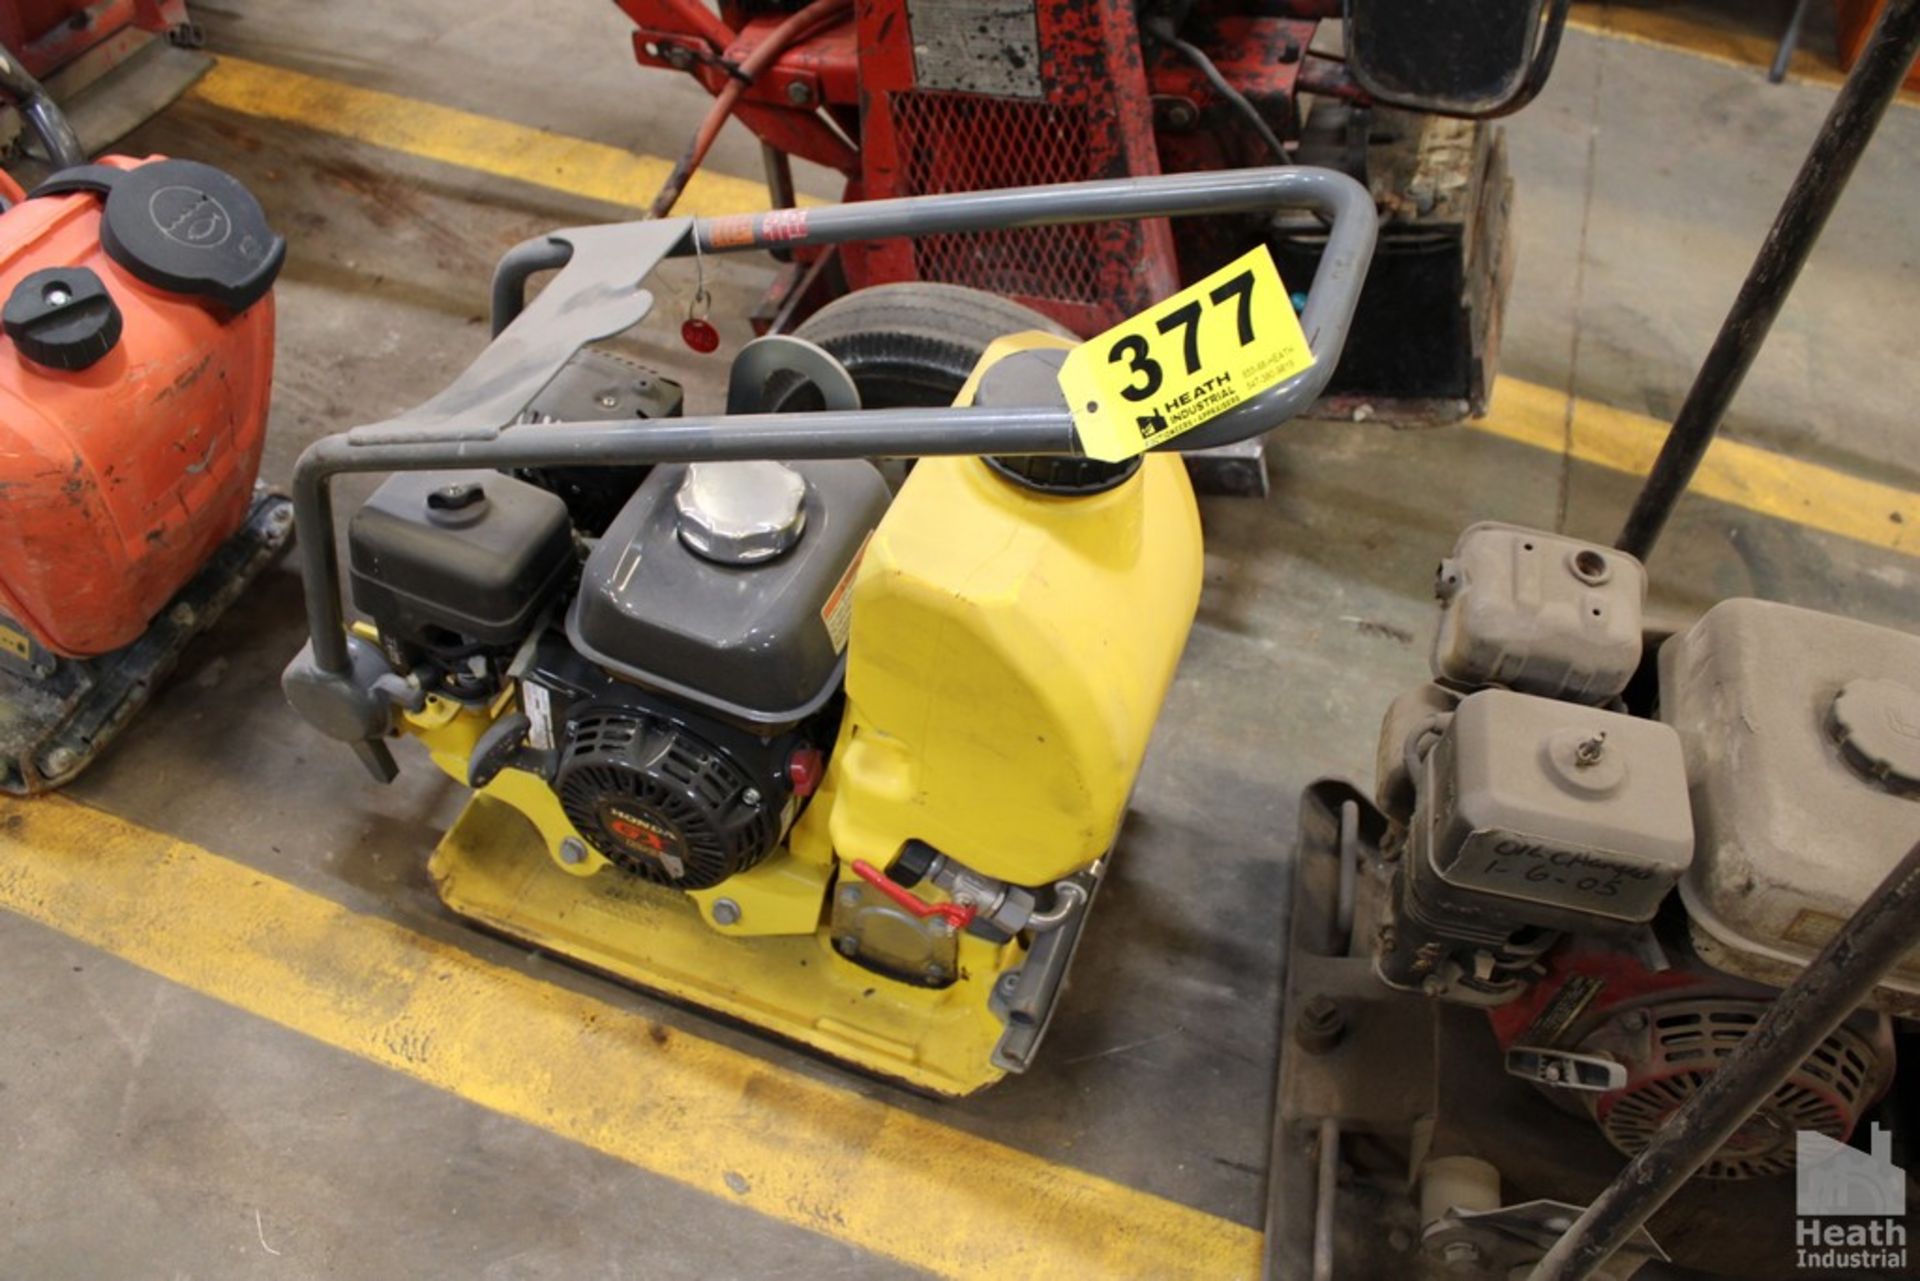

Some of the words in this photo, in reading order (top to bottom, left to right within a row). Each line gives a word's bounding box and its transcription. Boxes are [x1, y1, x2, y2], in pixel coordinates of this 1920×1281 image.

[1108, 269, 1255, 402] 377
[1165, 371, 1231, 413] HEATH
[1170, 386, 1236, 424] INDUSTRIAL
[611, 808, 676, 840] HONDA
